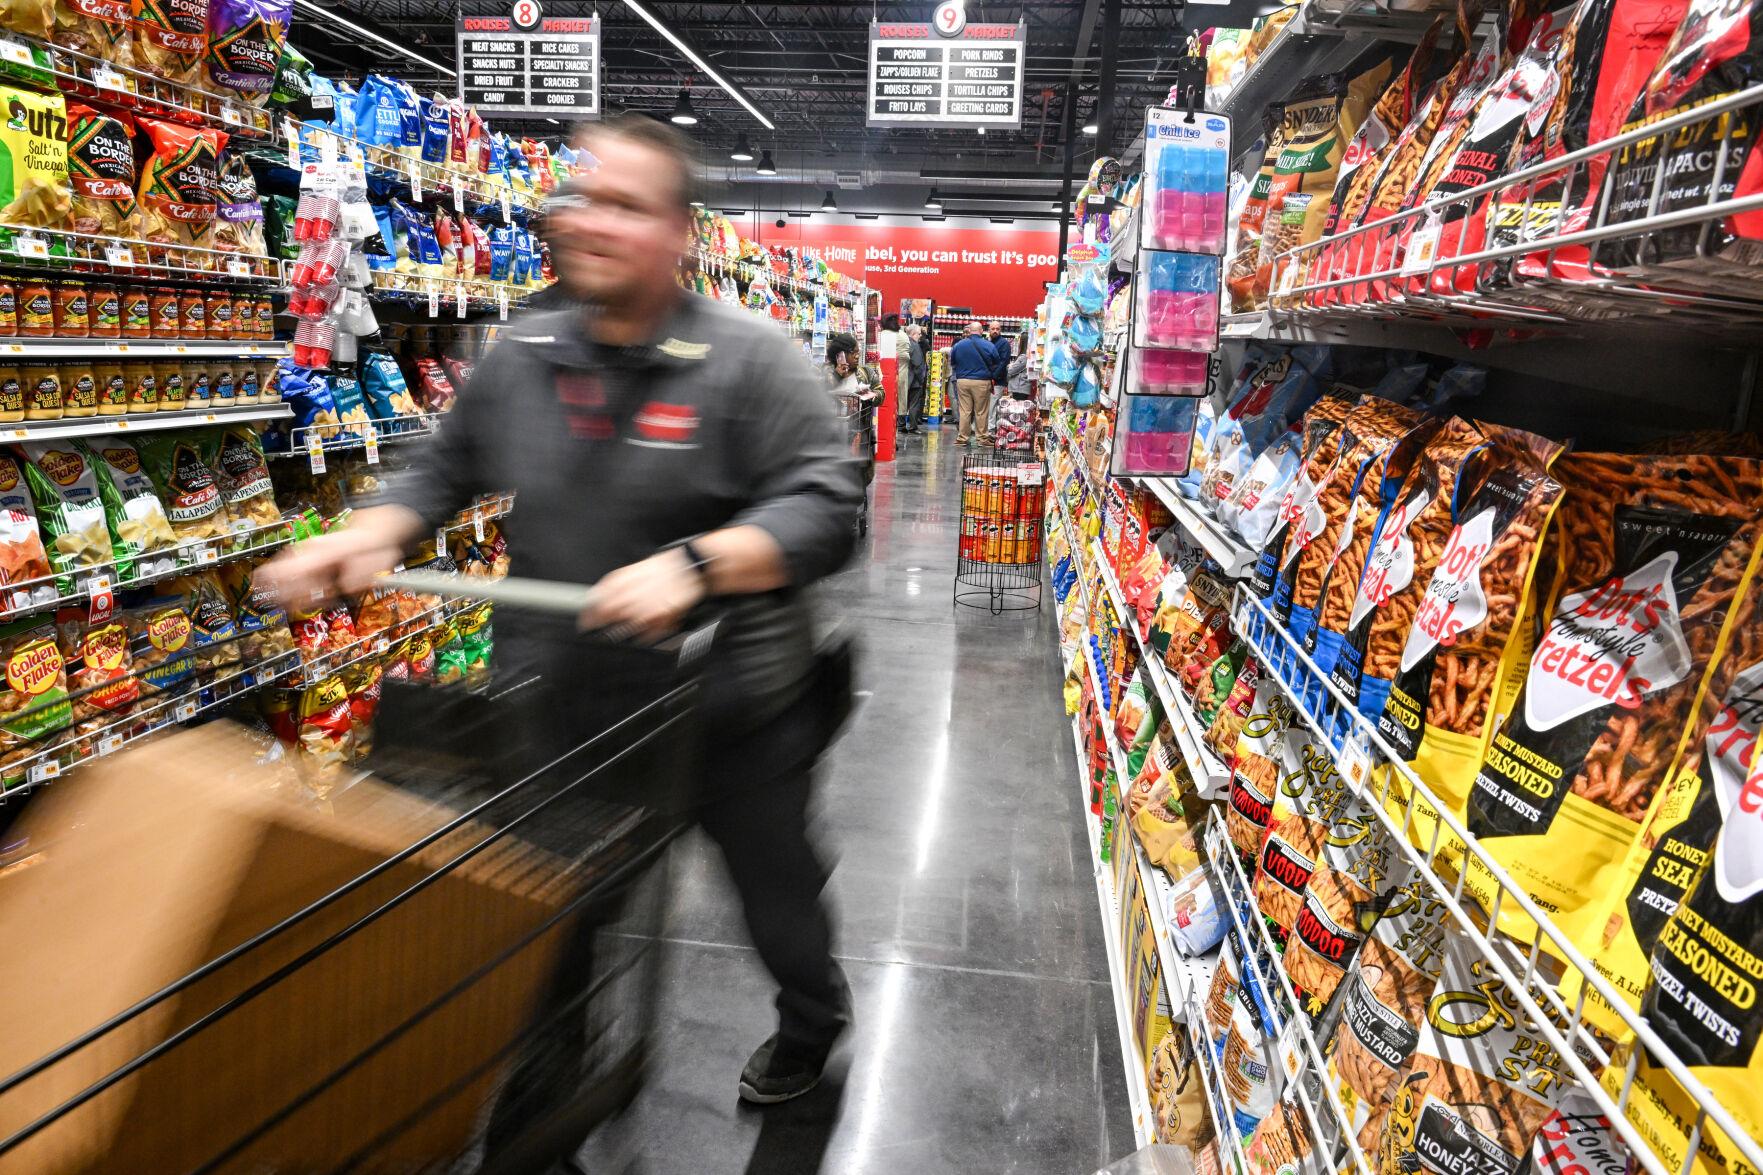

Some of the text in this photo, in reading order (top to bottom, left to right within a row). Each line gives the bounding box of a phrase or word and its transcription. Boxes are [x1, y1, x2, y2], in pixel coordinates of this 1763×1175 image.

[170, 1, 208, 18] BORDE
[519, 3, 532, 24] 8
[464, 19, 591, 32] ROUSES MARKET
[943, 8, 957, 28] 9
[159, 32, 189, 49] Café
[879, 26, 1016, 39] ROUSES MARKET
[236, 38, 267, 51] ON THE
[472, 42, 515, 52] MEAT SNACKS
[542, 43, 579, 53] RICE CAKES
[231, 44, 276, 65] BORDER
[893, 49, 926, 60] POPCORN
[962, 50, 1003, 61] PORK RINDS
[472, 59, 515, 69] SNACKS NUTS
[534, 60, 589, 70] SPECIALTY SNACKS
[922, 67, 939, 77] FLAKE
[215, 72, 255, 88] Cantina
[474, 76, 513, 86] DRIED FRUIT
[965, 68, 998, 78] PRETZELS
[543, 78, 579, 87] CRACKERS
[884, 85, 932, 95] ROUSES CHIPS
[483, 92, 504, 102] CANDY
[547, 94, 575, 104] COOKIES
[954, 86, 1008, 96] TORTILLA CHIPS
[888, 102, 926, 112] FRITO LAYS
[951, 103, 1008, 113] GREETING CARDS
[1159, 124, 1183, 137] Chill
[28, 141, 48, 155] Salt
[94, 136, 130, 153] ON THE
[24, 156, 68, 178] Vinegar
[1457, 151, 1497, 171] GINAL
[187, 166, 201, 178] ON
[1257, 179, 1273, 193] SIZ
[1684, 186, 1700, 196] wt.
[1719, 184, 1735, 193] oz
[170, 204, 197, 218] Café
[1620, 200, 1640, 213] single
[900, 248, 928, 264] you
[931, 250, 958, 263] can
[962, 250, 998, 264] trust
[1027, 254, 1060, 268] goo
[884, 265, 940, 274] 3rd Generation
[223, 453, 255, 464] BORDER
[182, 494, 206, 506] Café
[9, 508, 30, 523] HOT
[1622, 521, 1671, 536] sweet
[1688, 530, 1728, 543] savory
[1576, 577, 1670, 632] Dot's
[92, 610, 110, 621] LOCAL
[1416, 595, 1464, 647] etzels
[152, 615, 183, 636] Golden
[160, 624, 188, 649] Flake
[1551, 606, 1651, 662] Homestyle
[10, 643, 58, 679] Golden
[96, 642, 122, 665] Flake
[22, 657, 61, 691] Flake
[1533, 628, 1651, 708] retzels
[1386, 696, 1420, 730] SONED
[1513, 744, 1563, 779] MUSTARD
[1485, 748, 1554, 799] SEASONED
[1233, 785, 1271, 825] VOODOO
[1476, 773, 1542, 823] RETZEL TWISTS
[1267, 849, 1311, 888] VOOD
[1529, 892, 1560, 913] Tang.
[1299, 907, 1345, 960] OODOO
[1699, 921, 1763, 981] MUSTARD
[1615, 976, 1626, 987] A
[1355, 997, 1377, 1025] JAZZY
[1380, 1007, 1398, 1026] STYLE
[1682, 990, 1742, 1048] TWISTS
[1354, 1016, 1402, 1065] MUSTARD
[1673, 1114, 1682, 1129] A
[1418, 1132, 1472, 1175] HONEY
